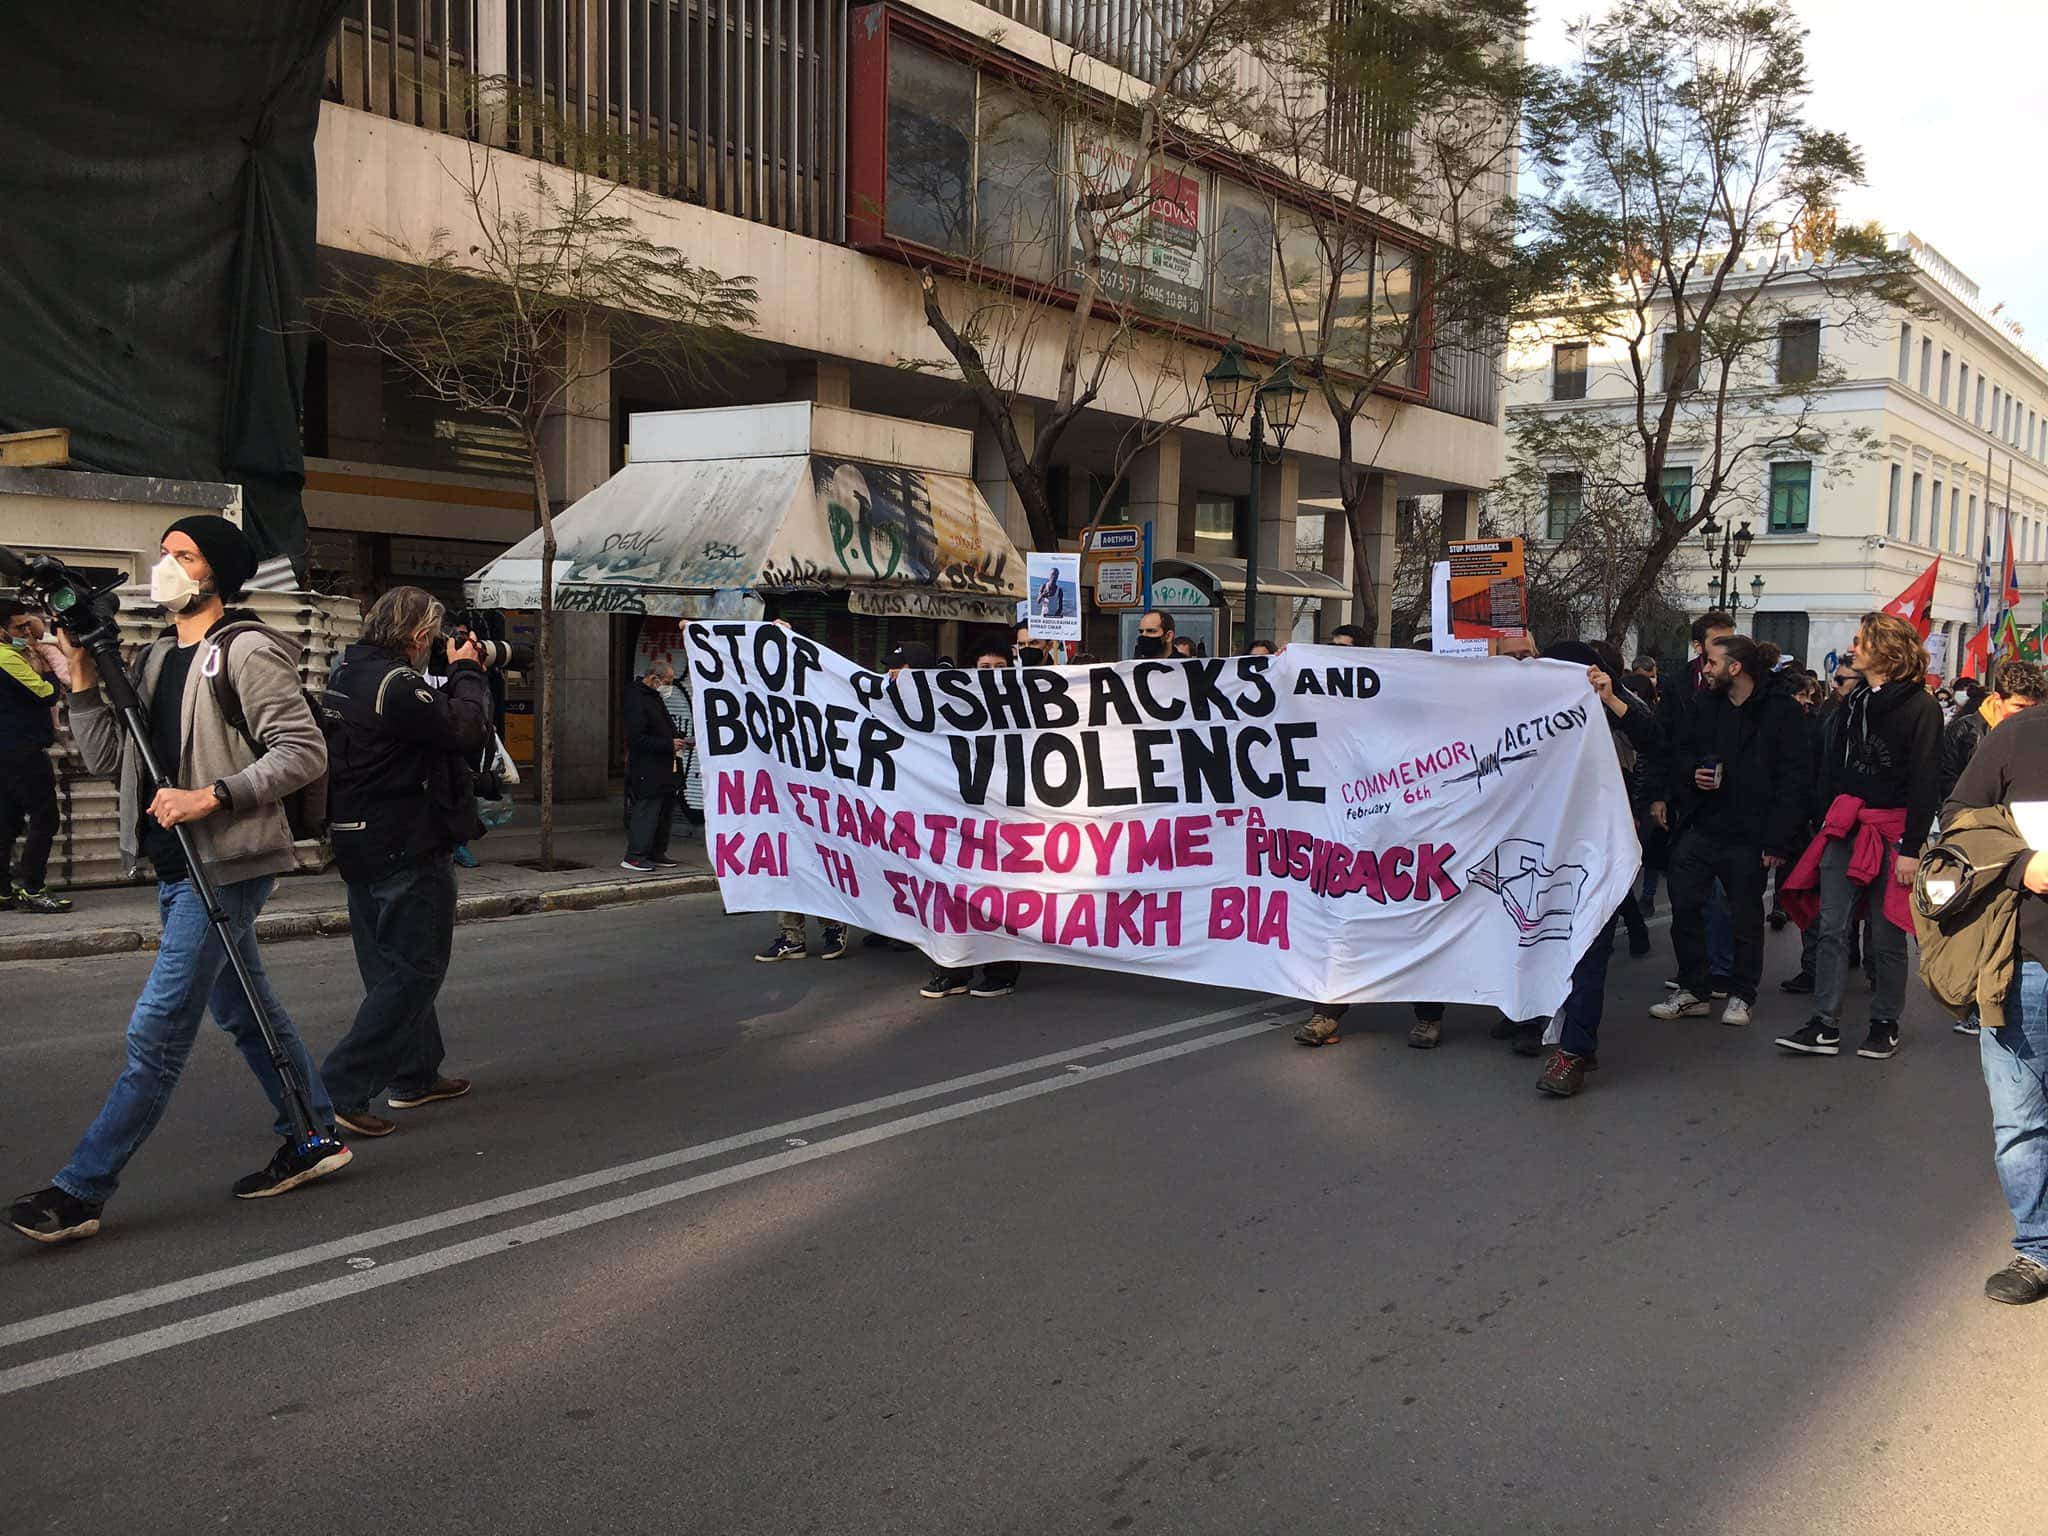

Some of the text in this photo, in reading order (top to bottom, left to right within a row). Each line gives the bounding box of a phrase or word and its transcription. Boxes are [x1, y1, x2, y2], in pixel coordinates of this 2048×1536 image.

[1103, 535, 1134, 545] ΑΦΕΤΗΡΙΑ
[1449, 545, 1464, 553] STOP
[689, 623, 1382, 734] STOP PUSHBACKS AND
[704, 687, 1327, 808] BORDER VIOLENCE
[1504, 705, 1588, 752] ACTION
[717, 769, 779, 816] ΝΑ
[787, 781, 1214, 877] ΣΤΑΜΑΤΗΣΟΥΜΕ
[1403, 785, 1432, 804] 6th
[716, 831, 1291, 951] ΚΑΙ ΤΗ ΣΥΝΟΡΙΑΚΗ ΒΙΑ
[1246, 826, 1462, 906] PUSHBACK
